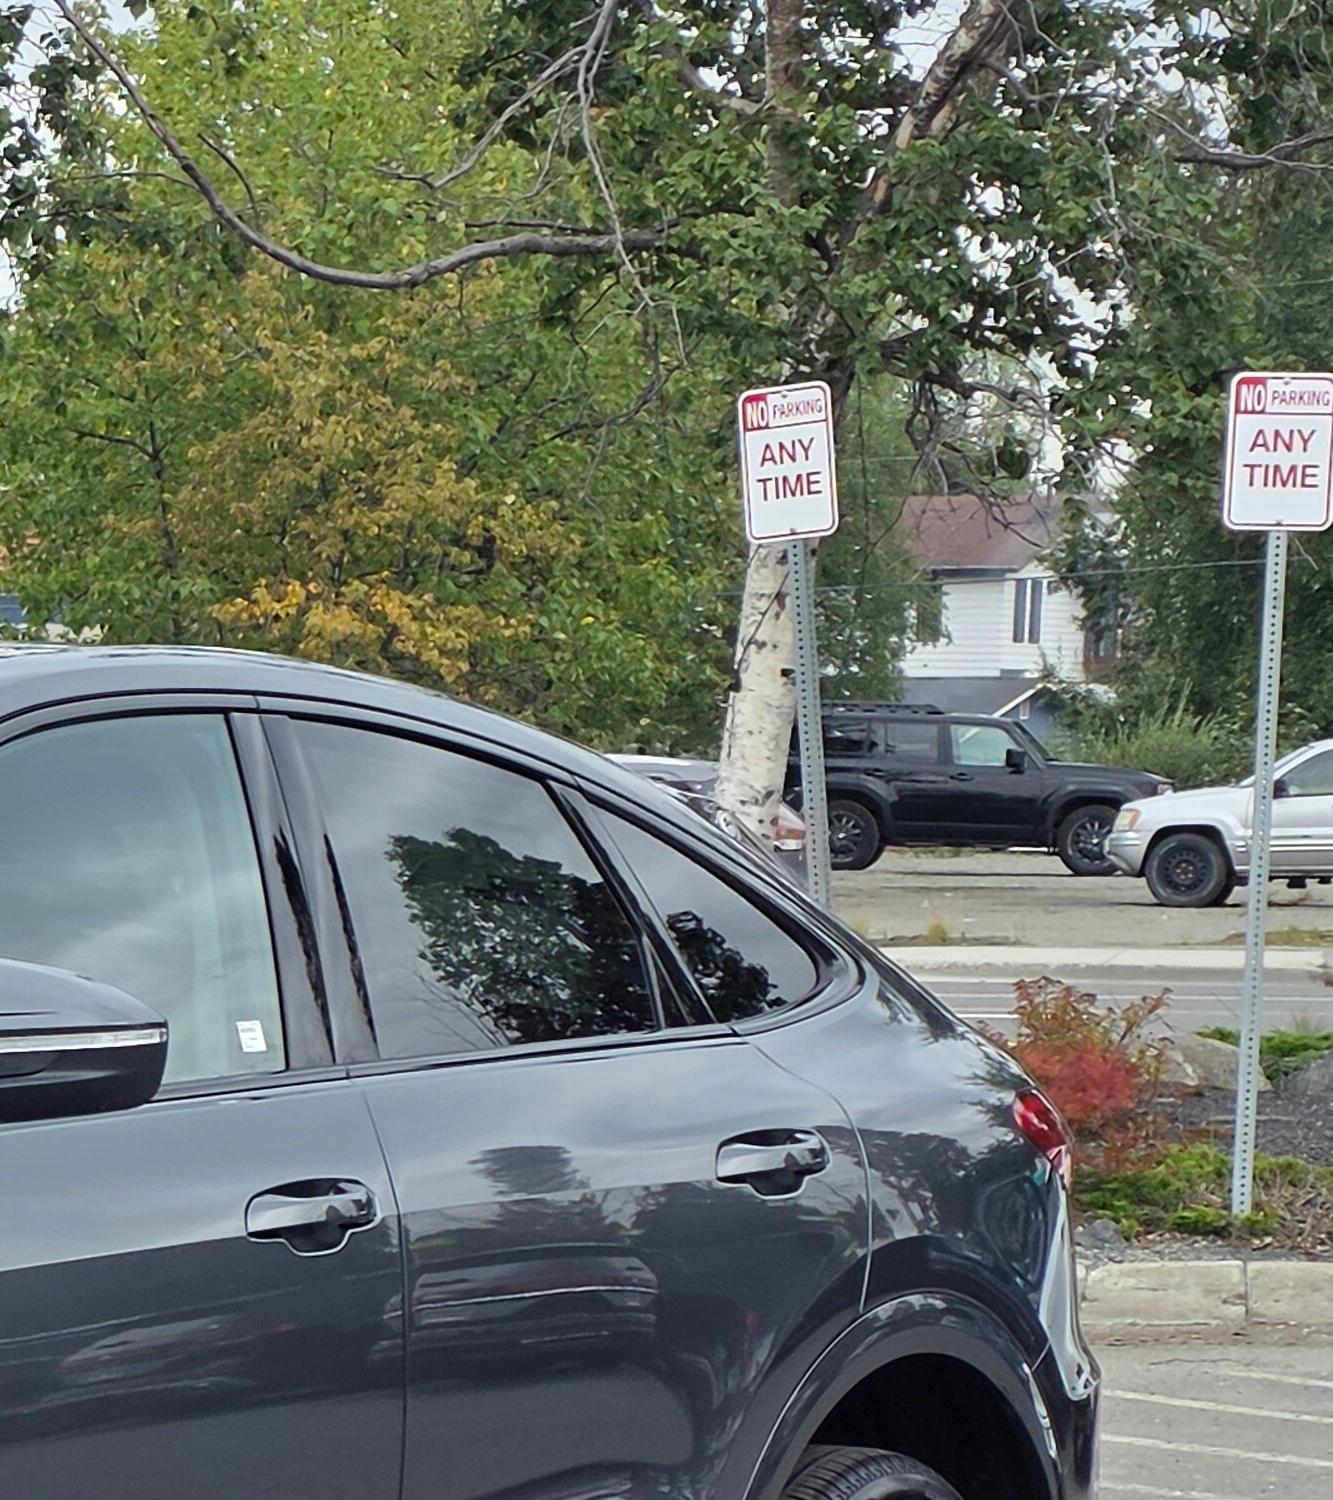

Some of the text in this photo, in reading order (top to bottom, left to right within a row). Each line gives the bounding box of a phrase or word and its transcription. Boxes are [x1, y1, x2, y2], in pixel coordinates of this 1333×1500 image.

[1240, 384, 1330, 411] NO PARKING
[746, 398, 823, 428] NO PARKING
[760, 437, 815, 467] ANY
[1249, 429, 1316, 453] ANY
[756, 471, 822, 501] TIME
[1243, 464, 1320, 488] TIME
